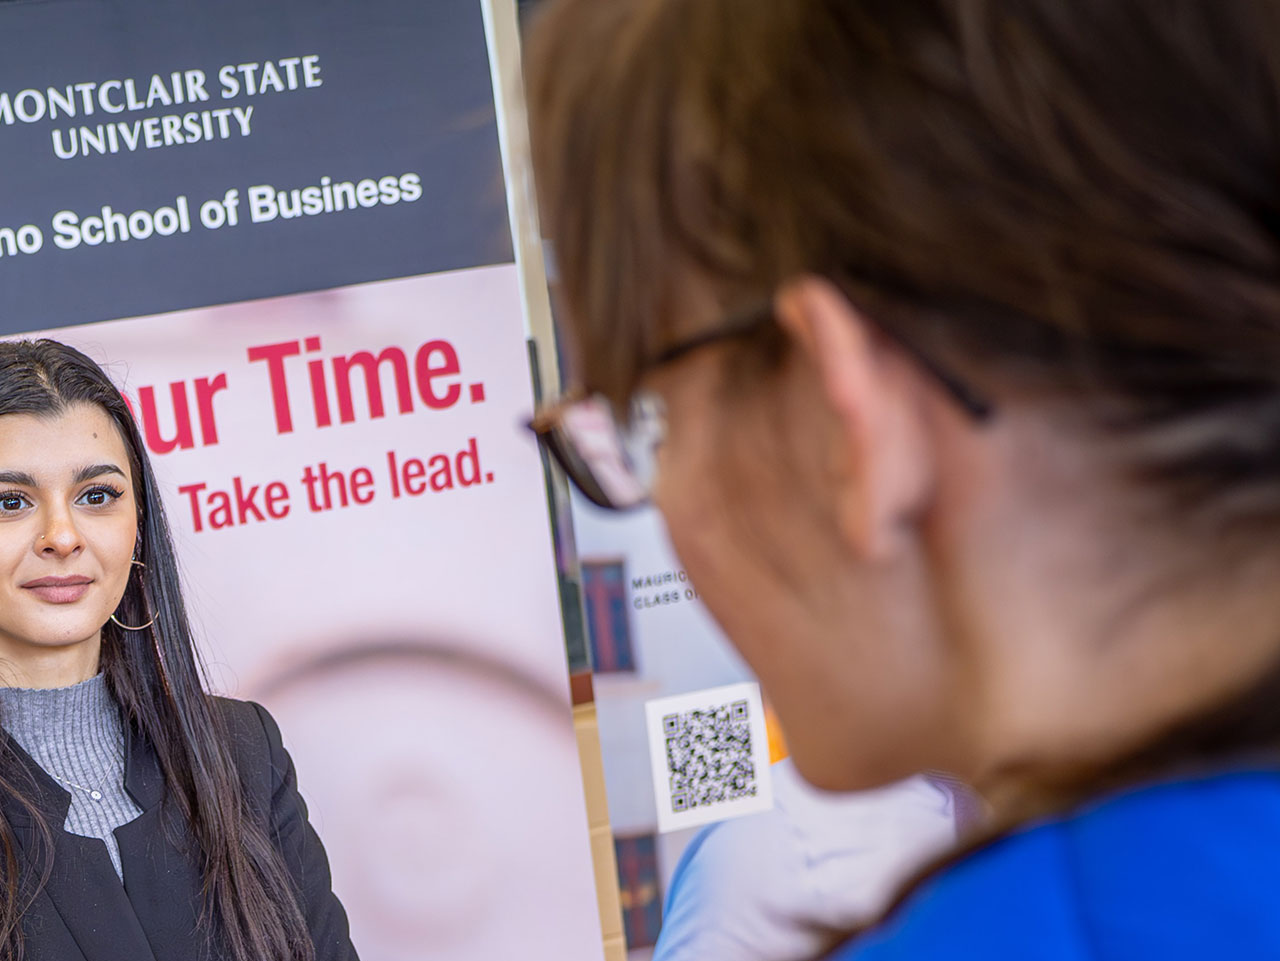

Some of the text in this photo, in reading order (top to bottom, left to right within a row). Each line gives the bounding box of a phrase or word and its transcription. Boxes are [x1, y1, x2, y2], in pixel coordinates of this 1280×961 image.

[218, 56, 323, 99] STATE
[51, 106, 254, 159] UNIVERSITY
[52, 196, 191, 250] School
[201, 189, 239, 229] of
[248, 173, 422, 223] Business
[120, 372, 228, 456] ur
[246, 335, 486, 435] Time.
[178, 437, 495, 533] Take the lead.
[632, 587, 699, 610] CLASS O
